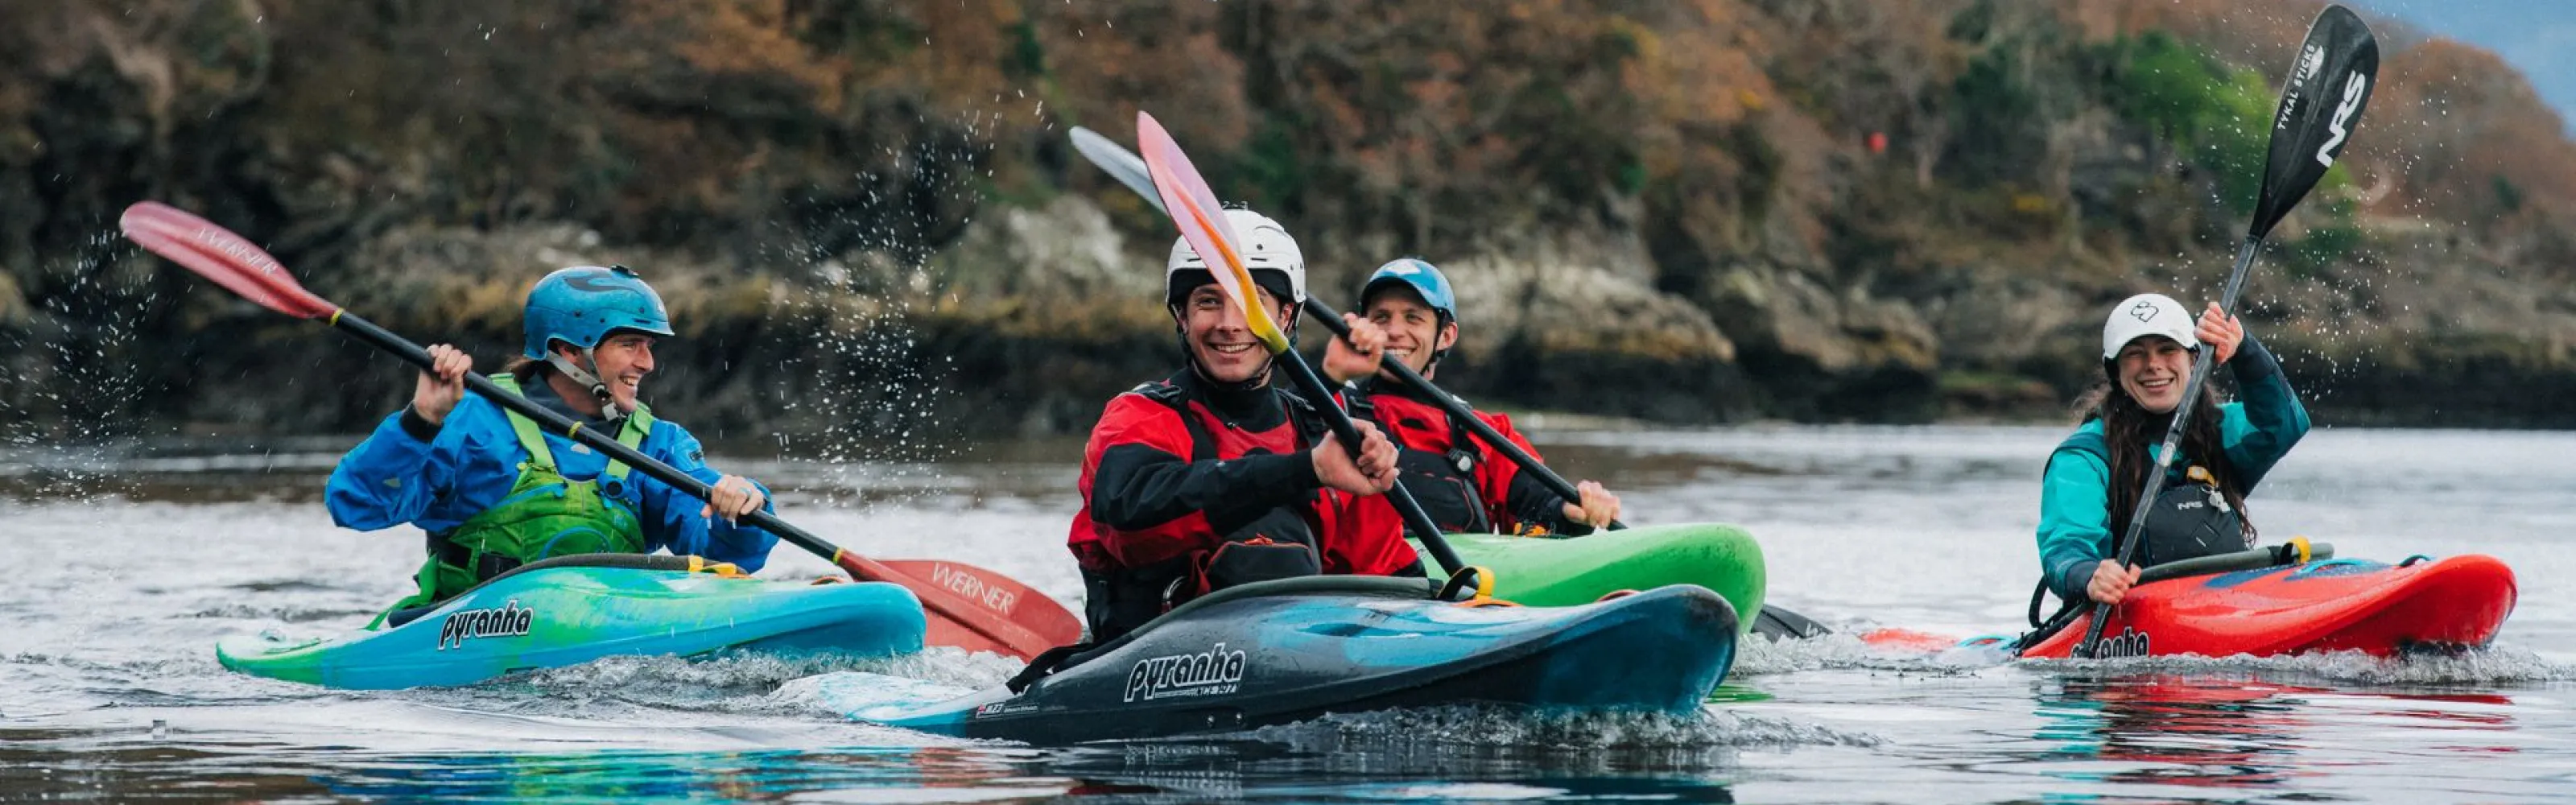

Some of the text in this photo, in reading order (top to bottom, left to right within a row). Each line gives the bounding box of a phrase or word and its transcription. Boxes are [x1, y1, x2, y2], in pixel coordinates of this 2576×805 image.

[2277, 43, 2315, 130] TYKAL STICKS
[2316, 70, 2366, 168] NRS
[196, 226, 279, 277] WERNER
[932, 561, 1014, 615] WERNER
[438, 598, 534, 650] pyranha
[2069, 625, 2150, 660] anha
[1124, 642, 1246, 703] pyranha
